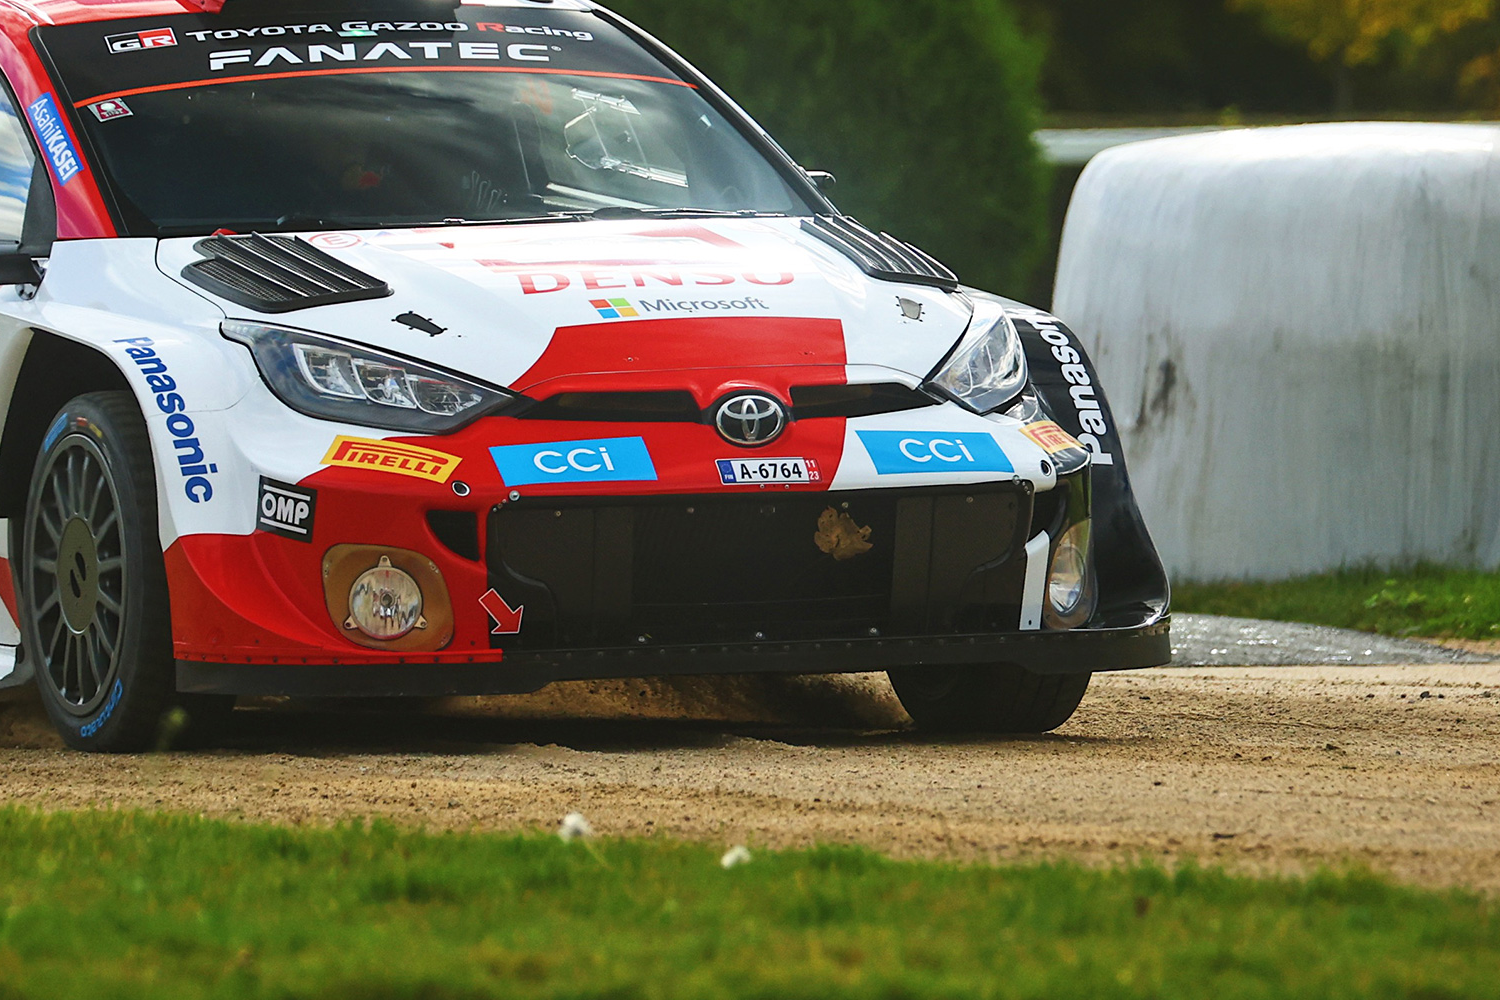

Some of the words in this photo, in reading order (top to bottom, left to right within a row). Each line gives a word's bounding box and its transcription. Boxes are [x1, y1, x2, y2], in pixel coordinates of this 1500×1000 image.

[111, 34, 177, 51] GR
[185, 23, 334, 42] TOYOTA
[340, 20, 469, 32] GAZOO
[475, 22, 594, 41] Racing
[638, 295, 771, 314] Microsoft
[112, 336, 219, 504] Panasonic
[332, 440, 449, 476] PIRELLI
[740, 462, 803, 479] A-6764
[808, 471, 820, 481] 23
[261, 492, 309, 525] OMP
